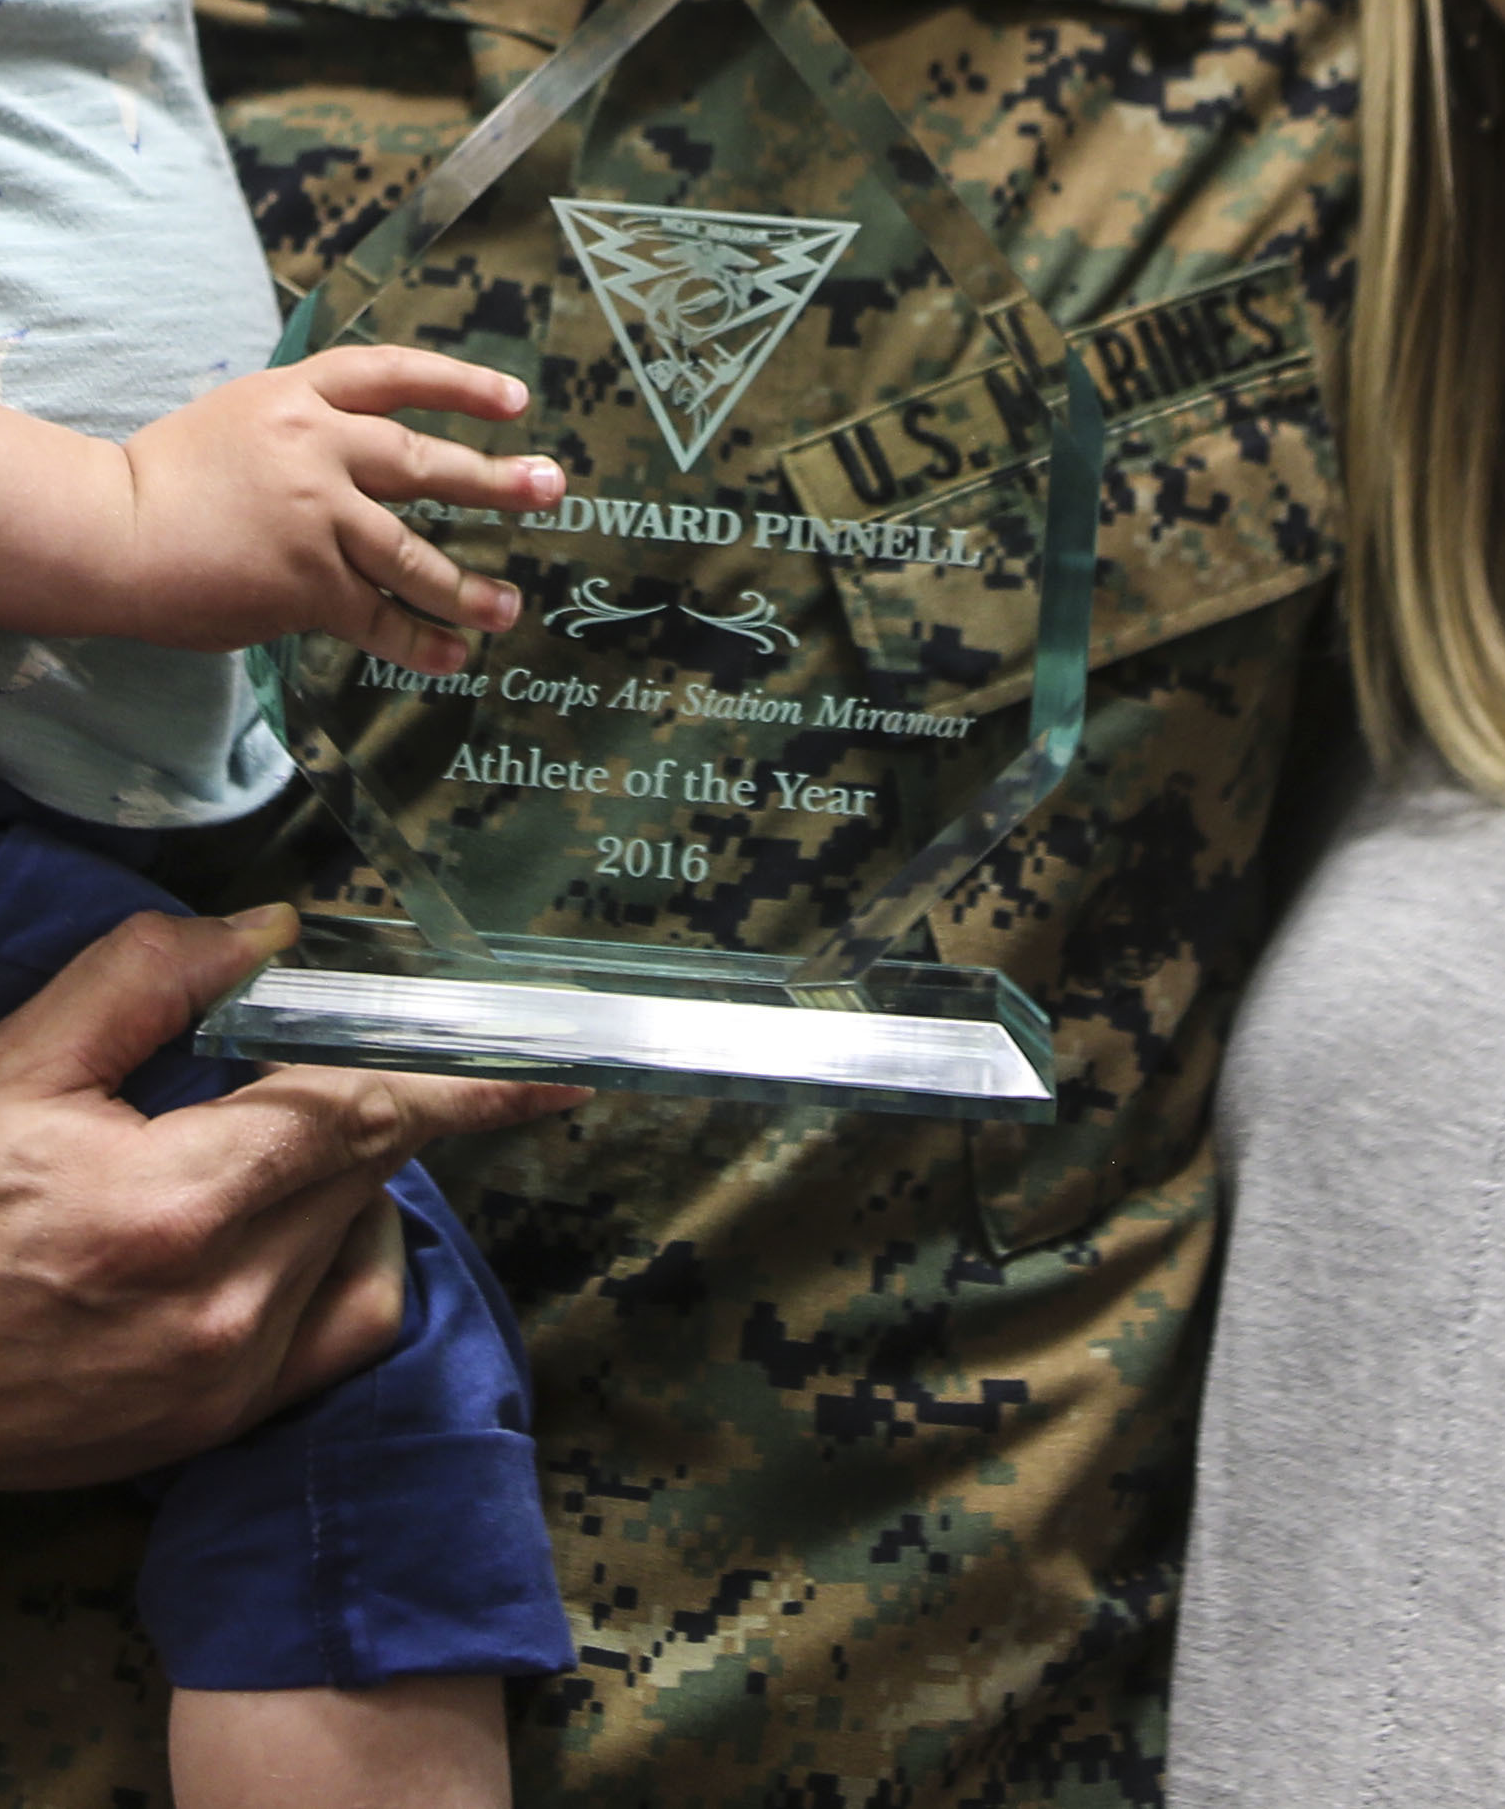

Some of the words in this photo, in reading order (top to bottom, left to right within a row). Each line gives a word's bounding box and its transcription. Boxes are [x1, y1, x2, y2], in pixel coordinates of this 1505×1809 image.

[831, 399, 993, 505] U.S.
[983, 285, 1284, 454] MRINES
[751, 511, 982, 568] PINNELL
[500, 667, 601, 717] Corps
[606, 677, 672, 712] Air
[679, 683, 804, 726] Station
[810, 694, 978, 740] Miramar
[441, 742, 610, 794] Athlete
[623, 758, 679, 800] of
[683, 762, 758, 808] the
[772, 770, 877, 818] Year
[595, 835, 711, 883] 2016
